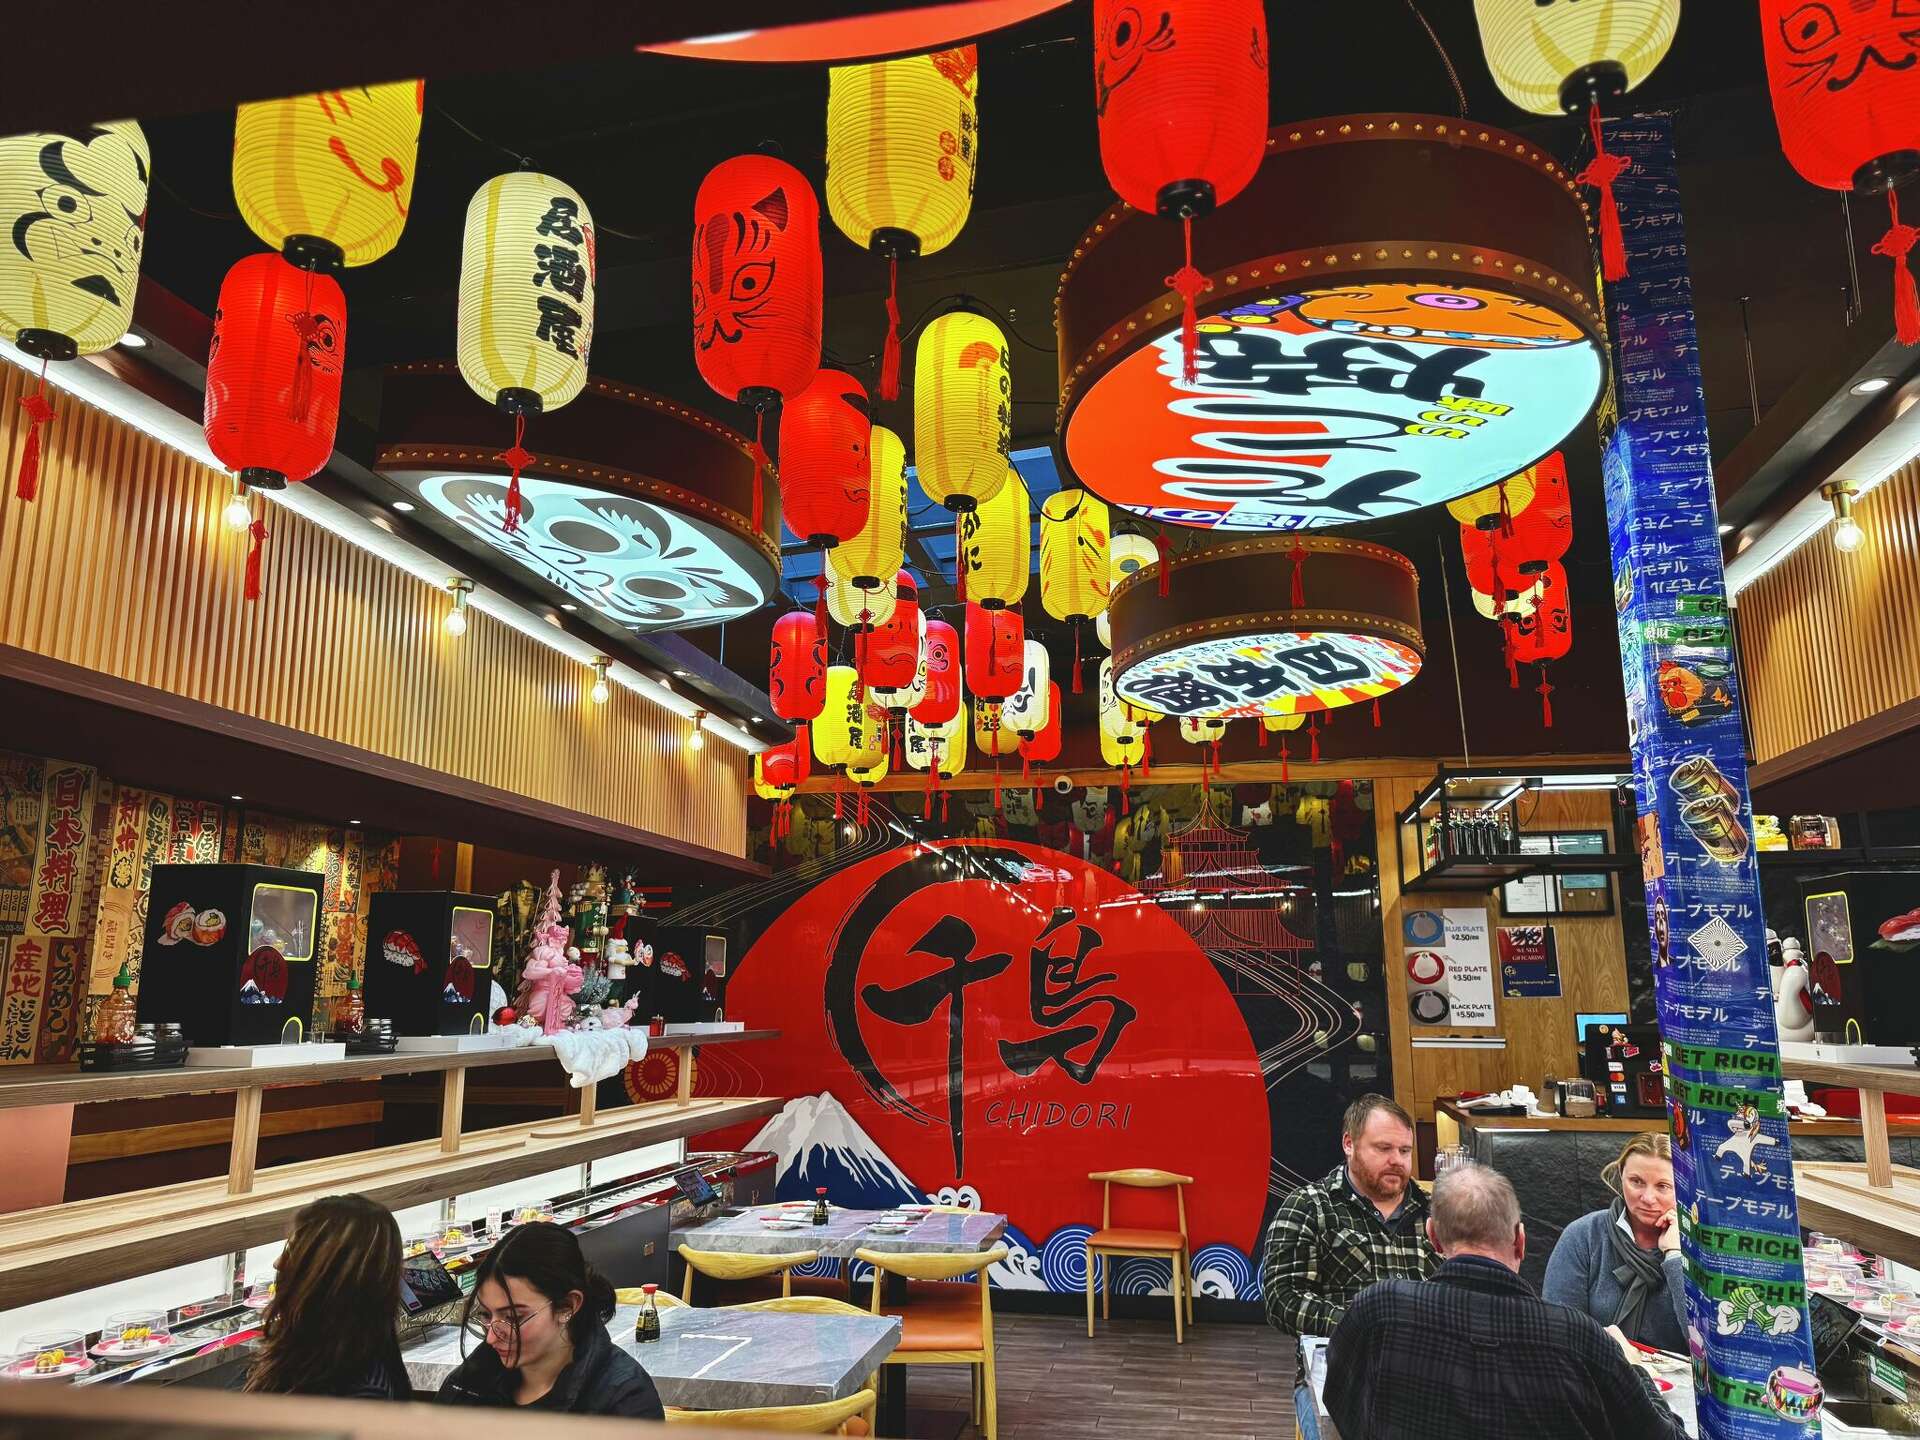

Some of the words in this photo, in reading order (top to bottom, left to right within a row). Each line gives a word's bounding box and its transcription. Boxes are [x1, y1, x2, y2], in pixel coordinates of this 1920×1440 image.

[533, 197, 586, 360] 居酒屋
[32, 771, 86, 933] 日本料理
[6, 938, 42, 997] 産地
[861, 906, 1138, 1180] 千鳥
[1714, 1052, 1775, 1073] RICH
[984, 1099, 1132, 1131] CHIDORI
[1695, 1188, 1794, 1220] テープモデル
[1738, 1235, 1801, 1259] RICH
